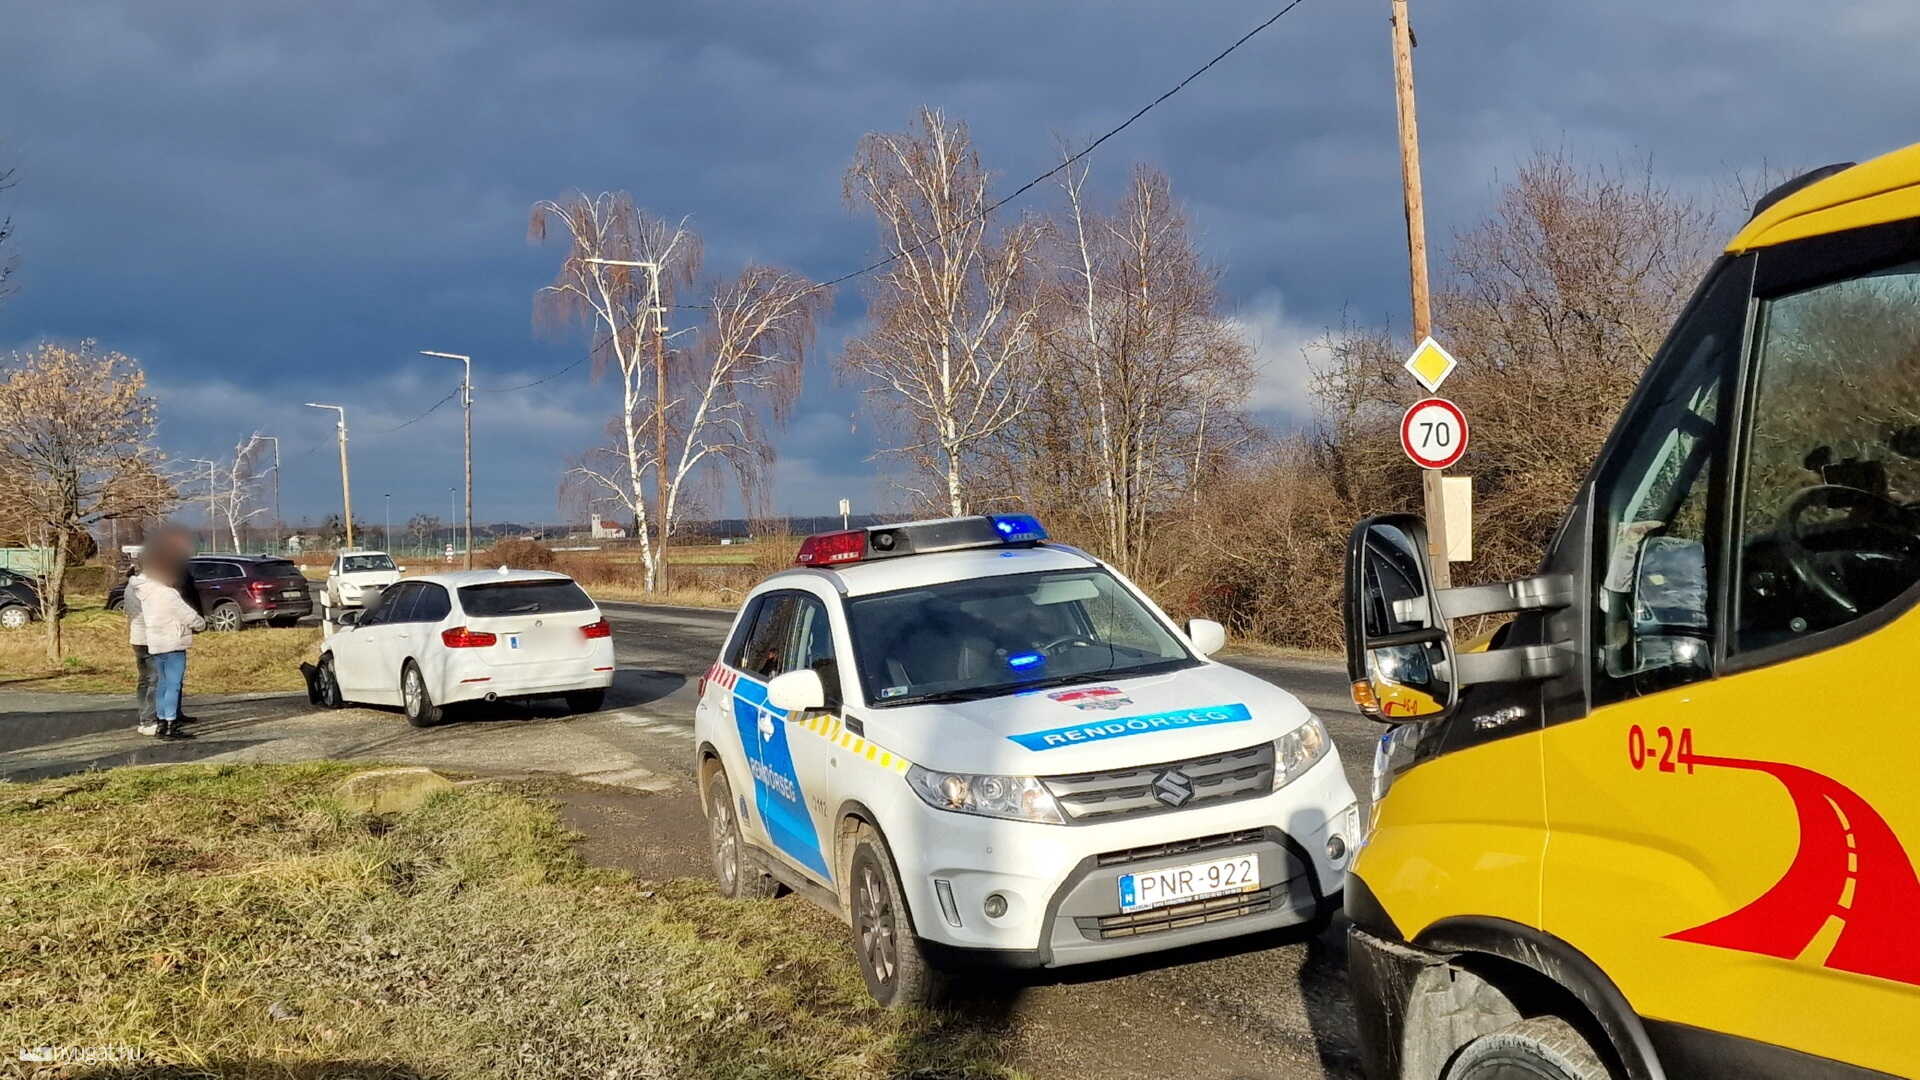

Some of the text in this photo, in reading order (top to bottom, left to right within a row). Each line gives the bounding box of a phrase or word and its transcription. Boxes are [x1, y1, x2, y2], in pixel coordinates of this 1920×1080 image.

[1420, 422, 1450, 448] 70
[1043, 709, 1229, 746] RENDŐRSÉG
[1628, 724, 1695, 775] 0-24
[1140, 859, 1253, 900] PNR-922
